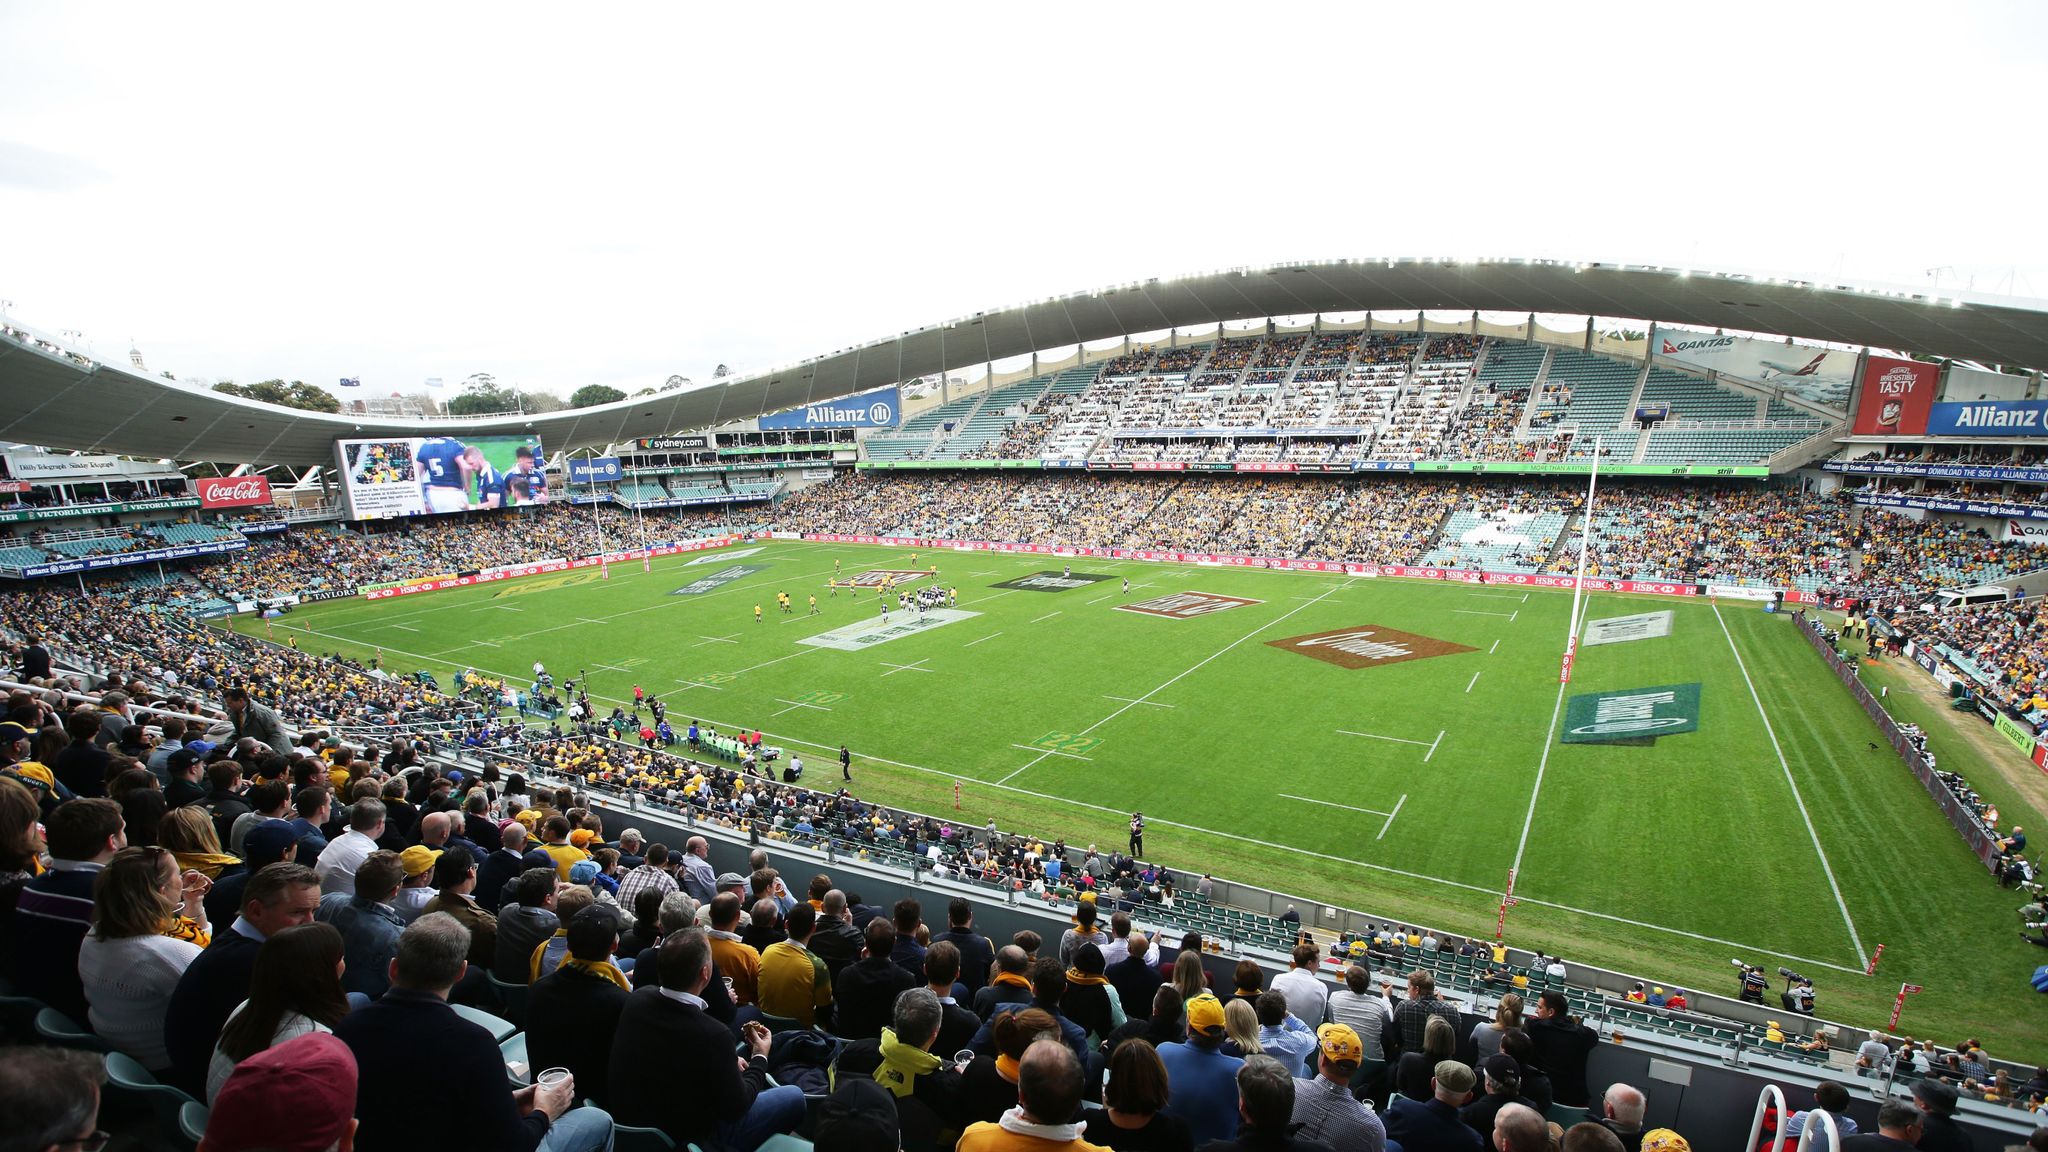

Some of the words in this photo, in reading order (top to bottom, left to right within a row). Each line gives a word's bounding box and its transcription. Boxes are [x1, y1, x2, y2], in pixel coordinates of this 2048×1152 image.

[1676, 336, 1735, 351] QANTAS
[1880, 381, 1916, 394] TASTY
[806, 407, 866, 423] Allianz
[1955, 405, 2039, 427] Allianz
[654, 438, 703, 448] sydney.com
[429, 458, 444, 477] 5
[575, 466, 605, 475] Allianz
[1928, 467, 1962, 475] DOWNLOAD
[1978, 469, 1992, 478] SCG
[1993, 470, 1998, 478] &
[2001, 471, 2029, 479] ALLIANZ
[206, 481, 263, 502] Coca-Cola
[130, 502, 169, 511] VICTORIA
[171, 499, 199, 507] BITTER
[1967, 505, 1990, 513] Allianz
[1999, 508, 2025, 516] Stadium
[37, 508, 80, 518] VICTORIA
[81, 506, 113, 514] BITTER
[199, 545, 218, 553] Allianz
[225, 541, 247, 550] Stadium
[120, 555, 144, 563] Stadium
[146, 552, 166, 560] Allianz
[174, 548, 197, 556] Stadium
[1217, 556, 1236, 564] HSBC
[1288, 561, 1307, 569] HSBC
[27, 568, 49, 576] Allianz
[59, 563, 84, 572] Stadium
[510, 568, 528, 577] HSBC
[542, 563, 559, 572] HSBC
[1404, 568, 1426, 577] HSBC
[476, 573, 494, 583] HSBC
[1447, 570, 1468, 579] HSBC
[1490, 574, 1513, 583] HSBC
[439, 579, 459, 588] HSBC
[1535, 577, 1560, 586] HSBC
[1583, 580, 1608, 589] HSBC
[368, 584, 398, 592] GILBERT
[400, 584, 422, 595] HSBC
[1632, 583, 1660, 593] HSBC
[806, 691, 845, 705] 10
[2003, 722, 2025, 746] GILBERT
[1040, 733, 1094, 753] 22
